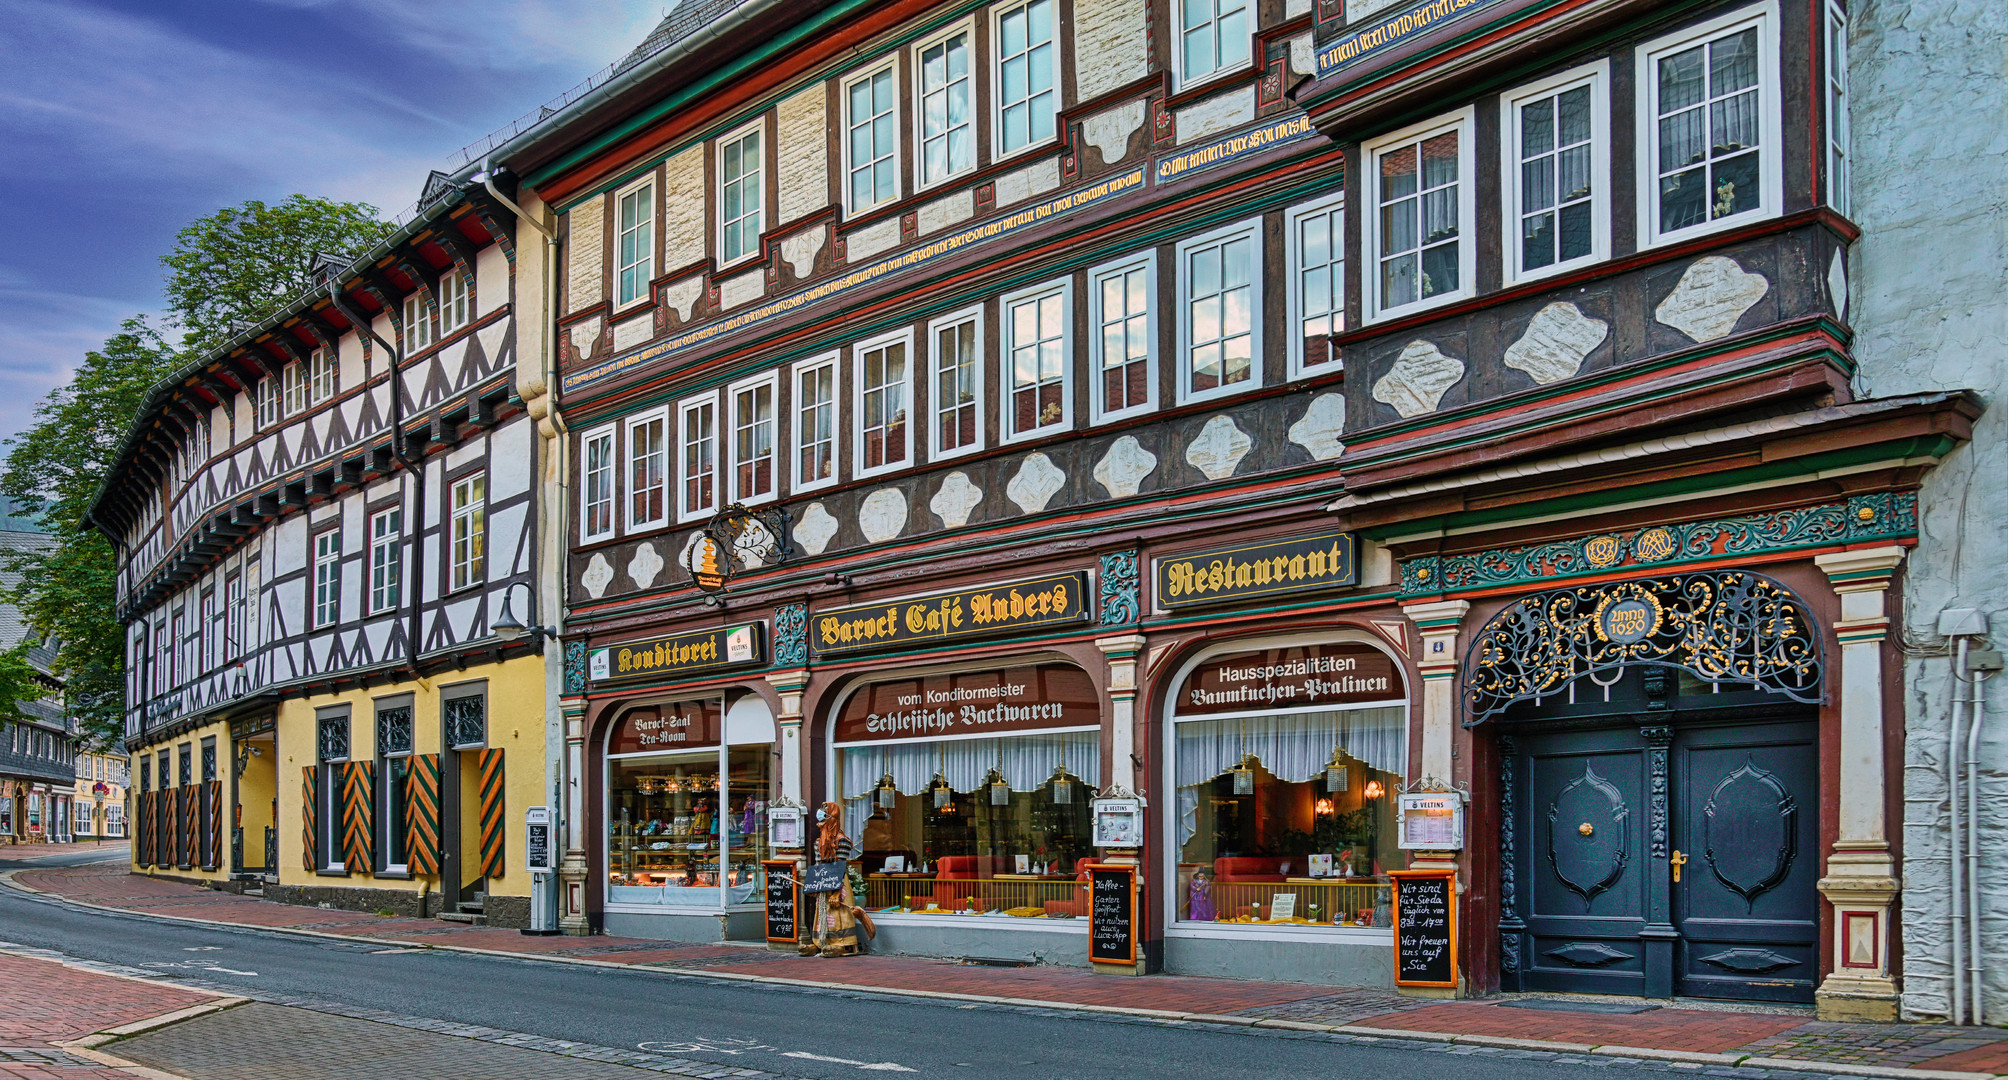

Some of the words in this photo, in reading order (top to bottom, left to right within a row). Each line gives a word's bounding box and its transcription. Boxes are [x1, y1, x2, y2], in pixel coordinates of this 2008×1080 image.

[1168, 540, 1342, 597] Restaurant
[821, 607, 898, 645] Barock
[905, 596, 964, 637] Café
[970, 583, 1069, 625] Anders
[618, 634, 718, 672] Konditorei
[1219, 656, 1356, 683] Hausspezialitäten
[898, 690, 922, 706] vom
[926, 683, 1026, 704] Konditormeister
[1190, 676, 1388, 705] Baumkuchen-Pralinen
[960, 701, 1063, 726] Backwaren
[634, 713, 691, 731] Barock-Saal
[639, 731, 686, 745] Tea-Room
[814, 867, 828, 877] Wir
[1401, 883, 1417, 893] Wir
[1418, 882, 1442, 893] sind
[1095, 895, 1121, 908] Garten
[1399, 895, 1414, 907] für
[1403, 905, 1430, 920] täglich
[1401, 935, 1417, 946] Wir
[1419, 935, 1448, 950] freuen
[1422, 946, 1442, 958] auf
